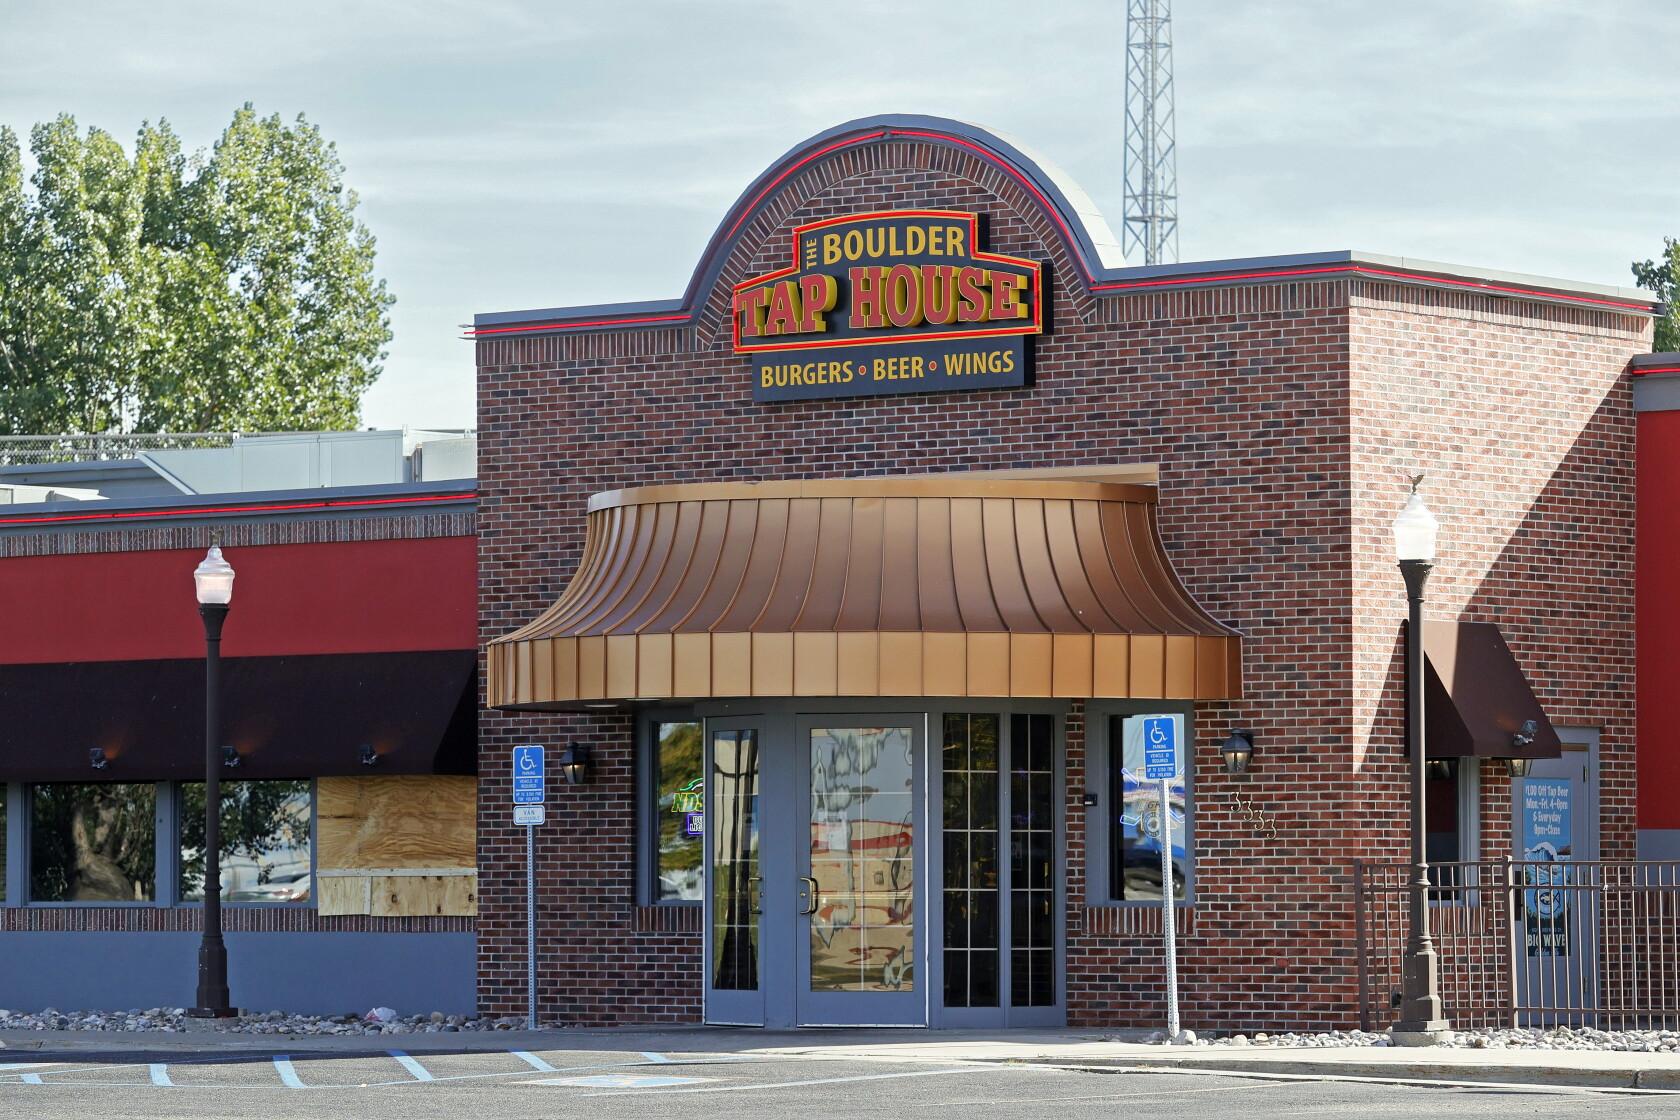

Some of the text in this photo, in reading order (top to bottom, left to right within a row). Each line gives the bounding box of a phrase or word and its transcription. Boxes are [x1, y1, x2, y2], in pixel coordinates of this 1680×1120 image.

[806, 238, 817, 270] THE
[823, 226, 965, 265] BOULDER
[736, 264, 1028, 336] TAP HOUSE
[761, 350, 1015, 388] BURGERS BEER WINGS
[671, 792, 703, 812] NDS
[1538, 785, 1547, 796] Off
[1547, 786, 1556, 798] Tap
[1557, 786, 1568, 797] Beer
[1230, 791, 1277, 840] 3333
[1538, 811, 1562, 824] Everyday
